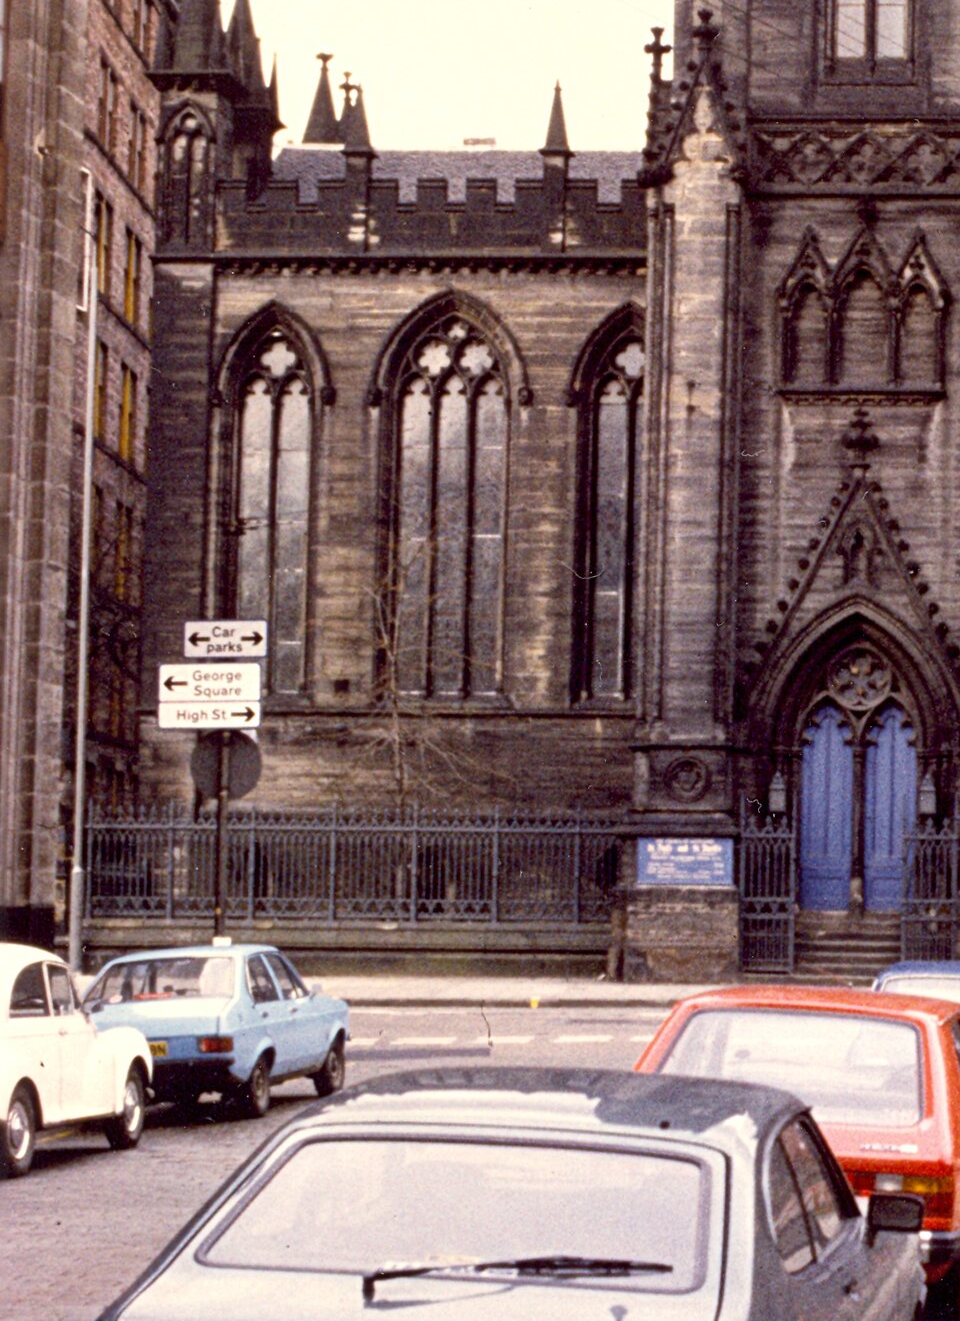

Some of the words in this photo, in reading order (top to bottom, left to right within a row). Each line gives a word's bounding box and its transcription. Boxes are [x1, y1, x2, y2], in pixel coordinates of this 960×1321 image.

[212, 626, 236, 638] Car
[206, 642, 243, 654] parks
[192, 670, 243, 683] George
[193, 685, 242, 698] Square
[176, 709, 208, 723] High
[211, 709, 227, 720] St
